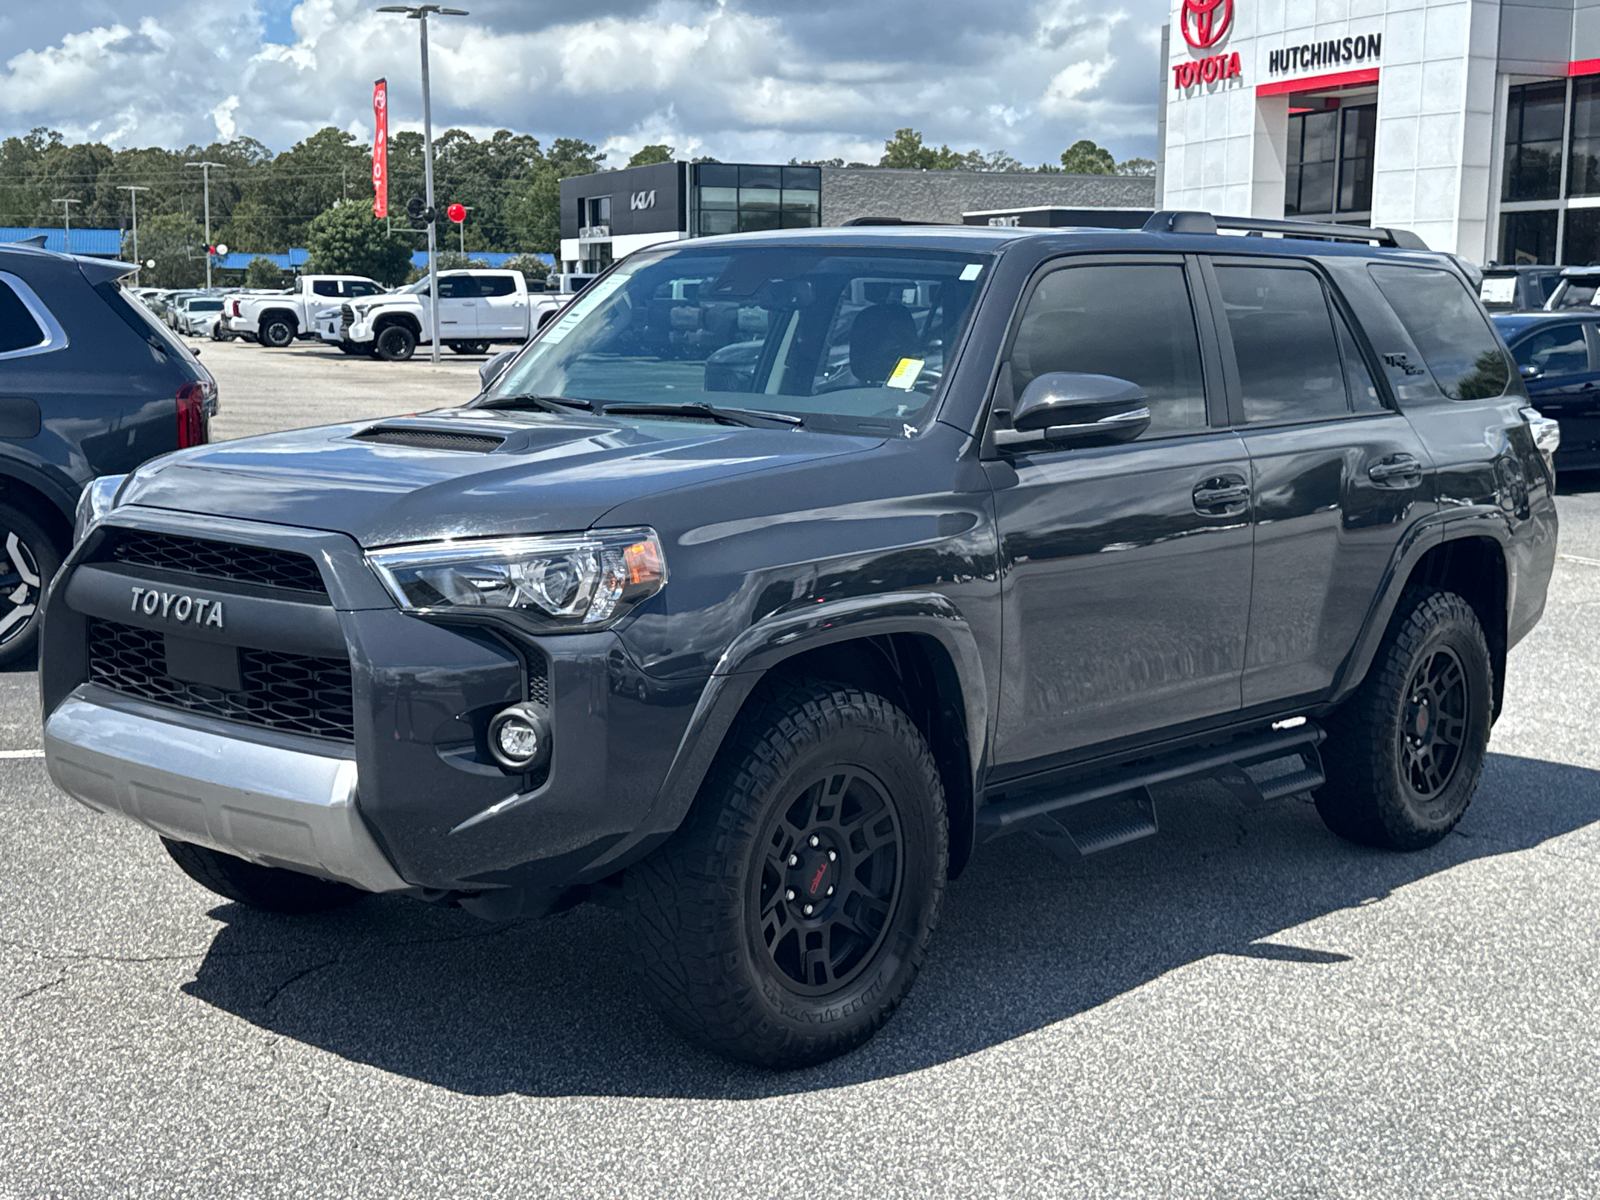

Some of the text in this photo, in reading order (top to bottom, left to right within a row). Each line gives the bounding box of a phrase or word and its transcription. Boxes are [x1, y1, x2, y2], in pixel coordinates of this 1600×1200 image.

[1172, 52, 1242, 90] TOYOTA
[1269, 33, 1382, 73] HUTCHINSON
[630, 190, 657, 211] KIA
[131, 586, 223, 628] TOYOTA
